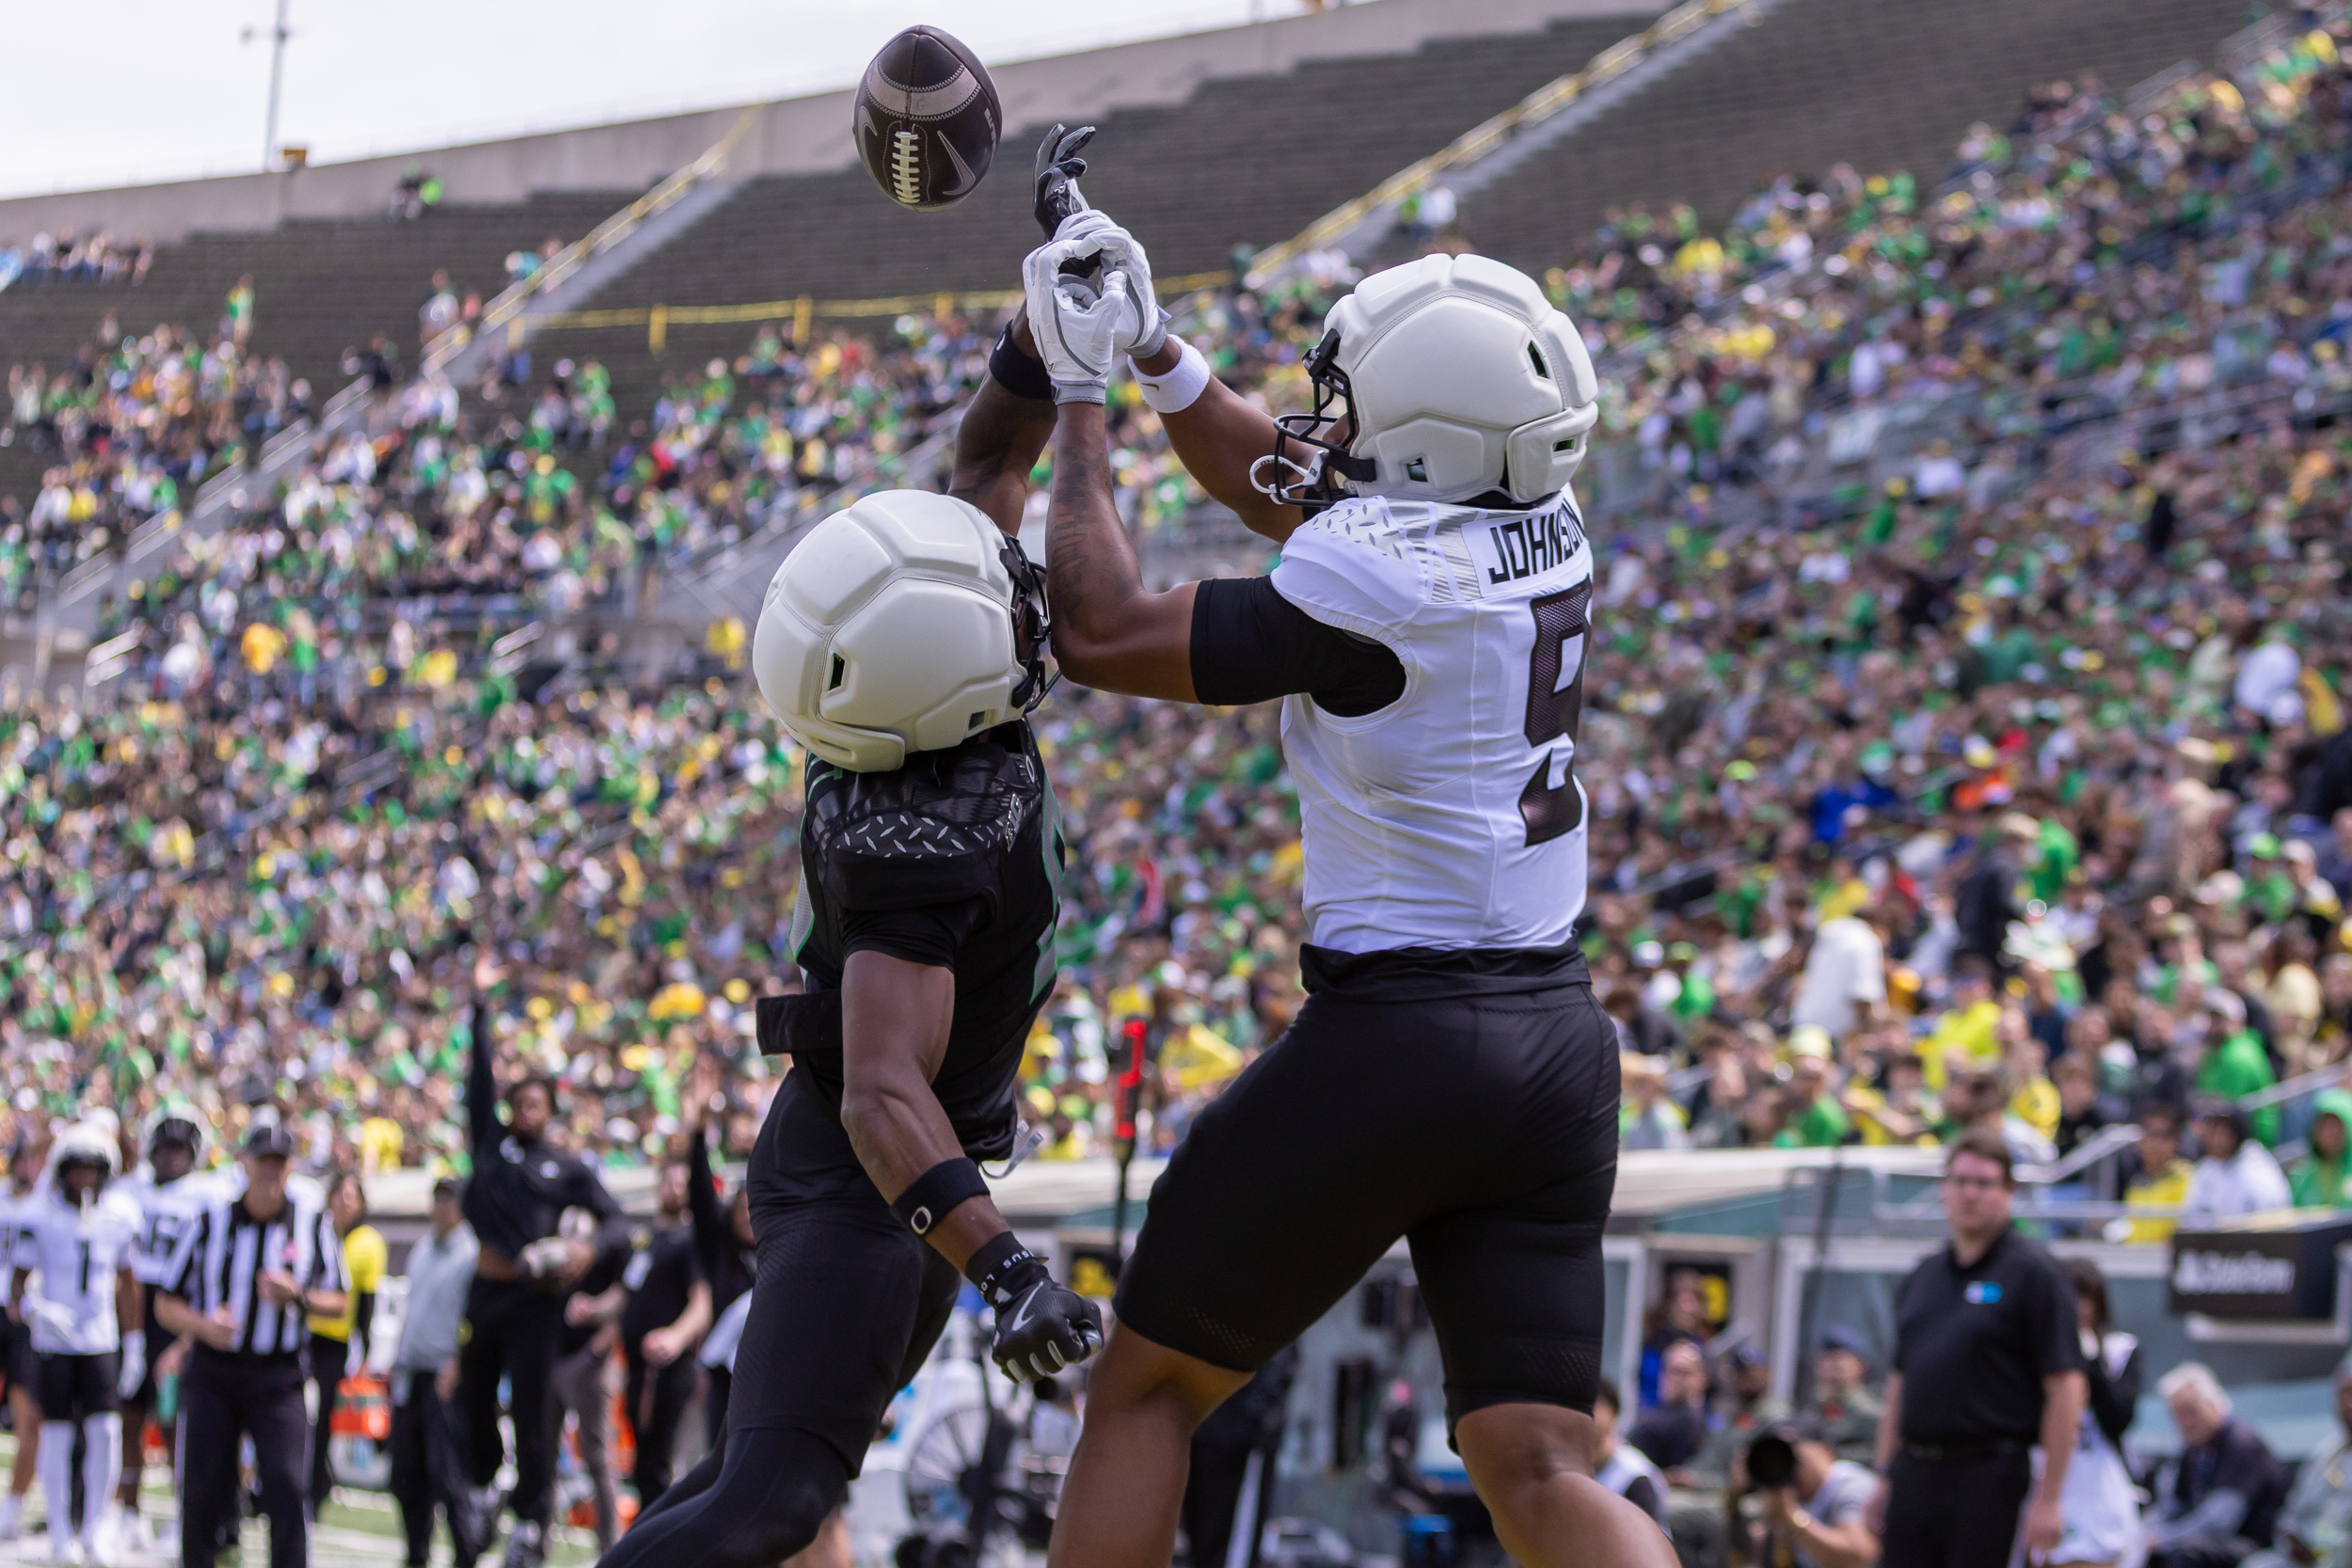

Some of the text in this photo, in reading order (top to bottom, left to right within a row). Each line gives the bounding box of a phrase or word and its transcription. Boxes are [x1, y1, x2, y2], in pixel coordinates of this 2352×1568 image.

[1487, 497, 1586, 585] JOHNSON
[1518, 573, 1593, 848] 9
[1003, 1250, 1035, 1268] SUS
